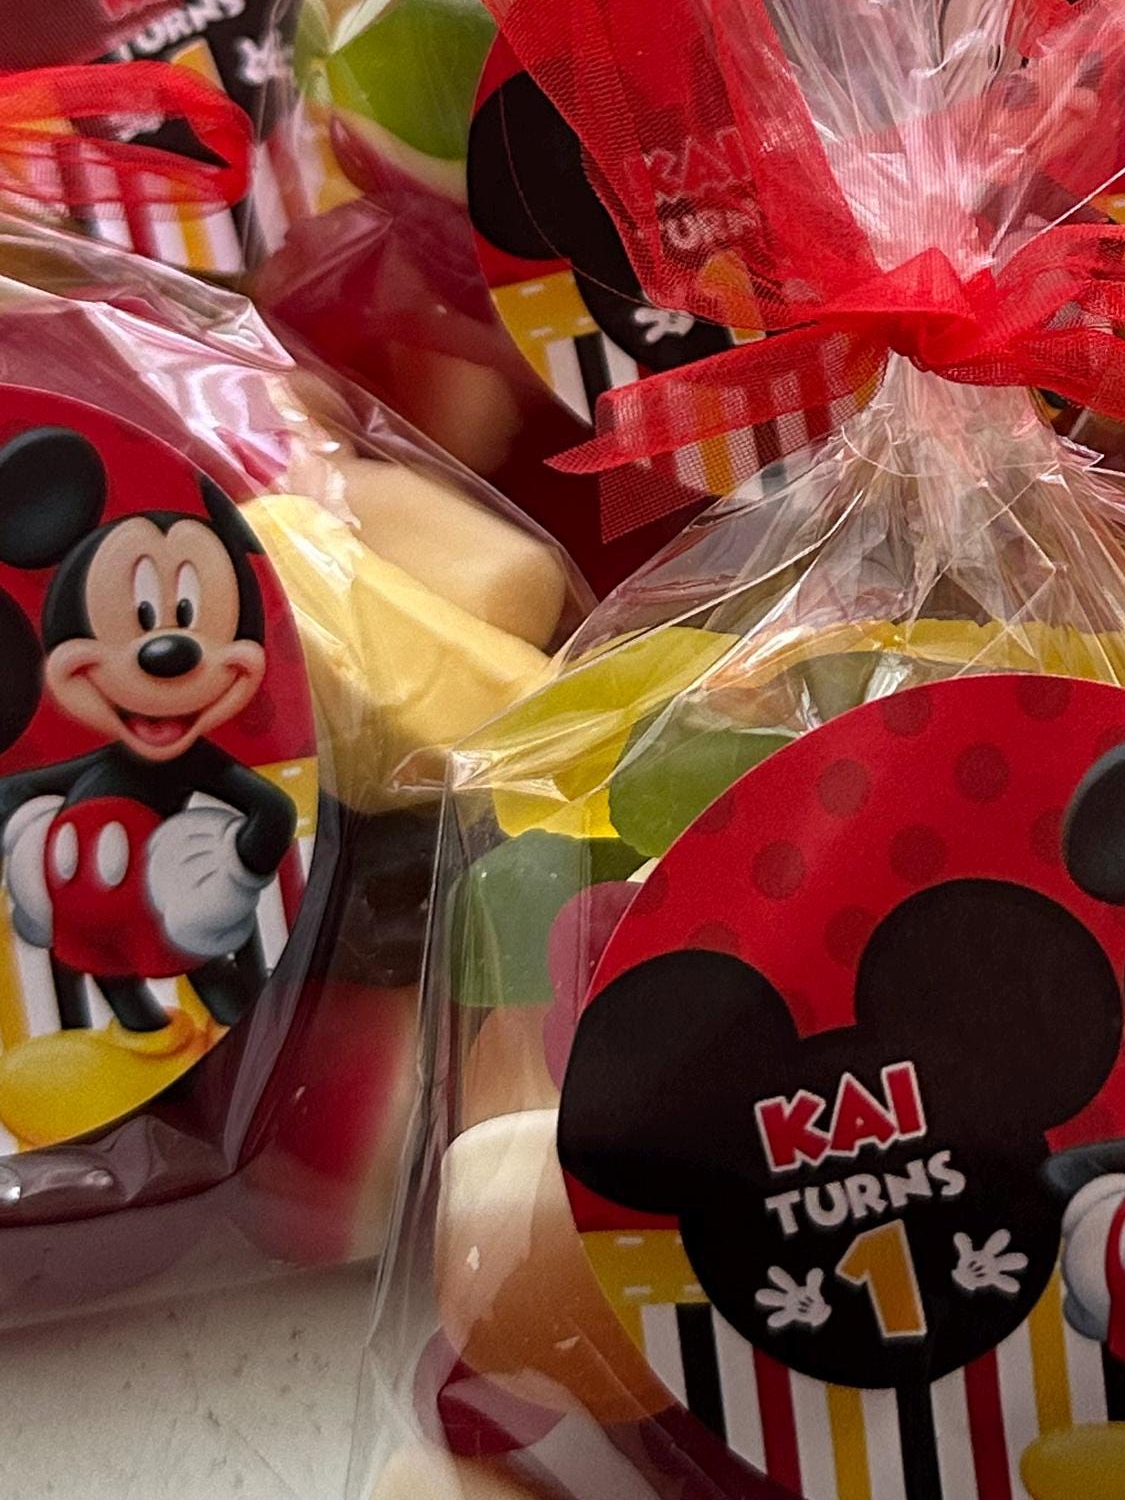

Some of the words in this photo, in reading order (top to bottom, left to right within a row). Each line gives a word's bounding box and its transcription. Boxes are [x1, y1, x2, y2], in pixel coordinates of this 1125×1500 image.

[754, 1060, 927, 1173] KAI
[765, 1150, 967, 1236] TURNS
[835, 1218, 928, 1339] 1
